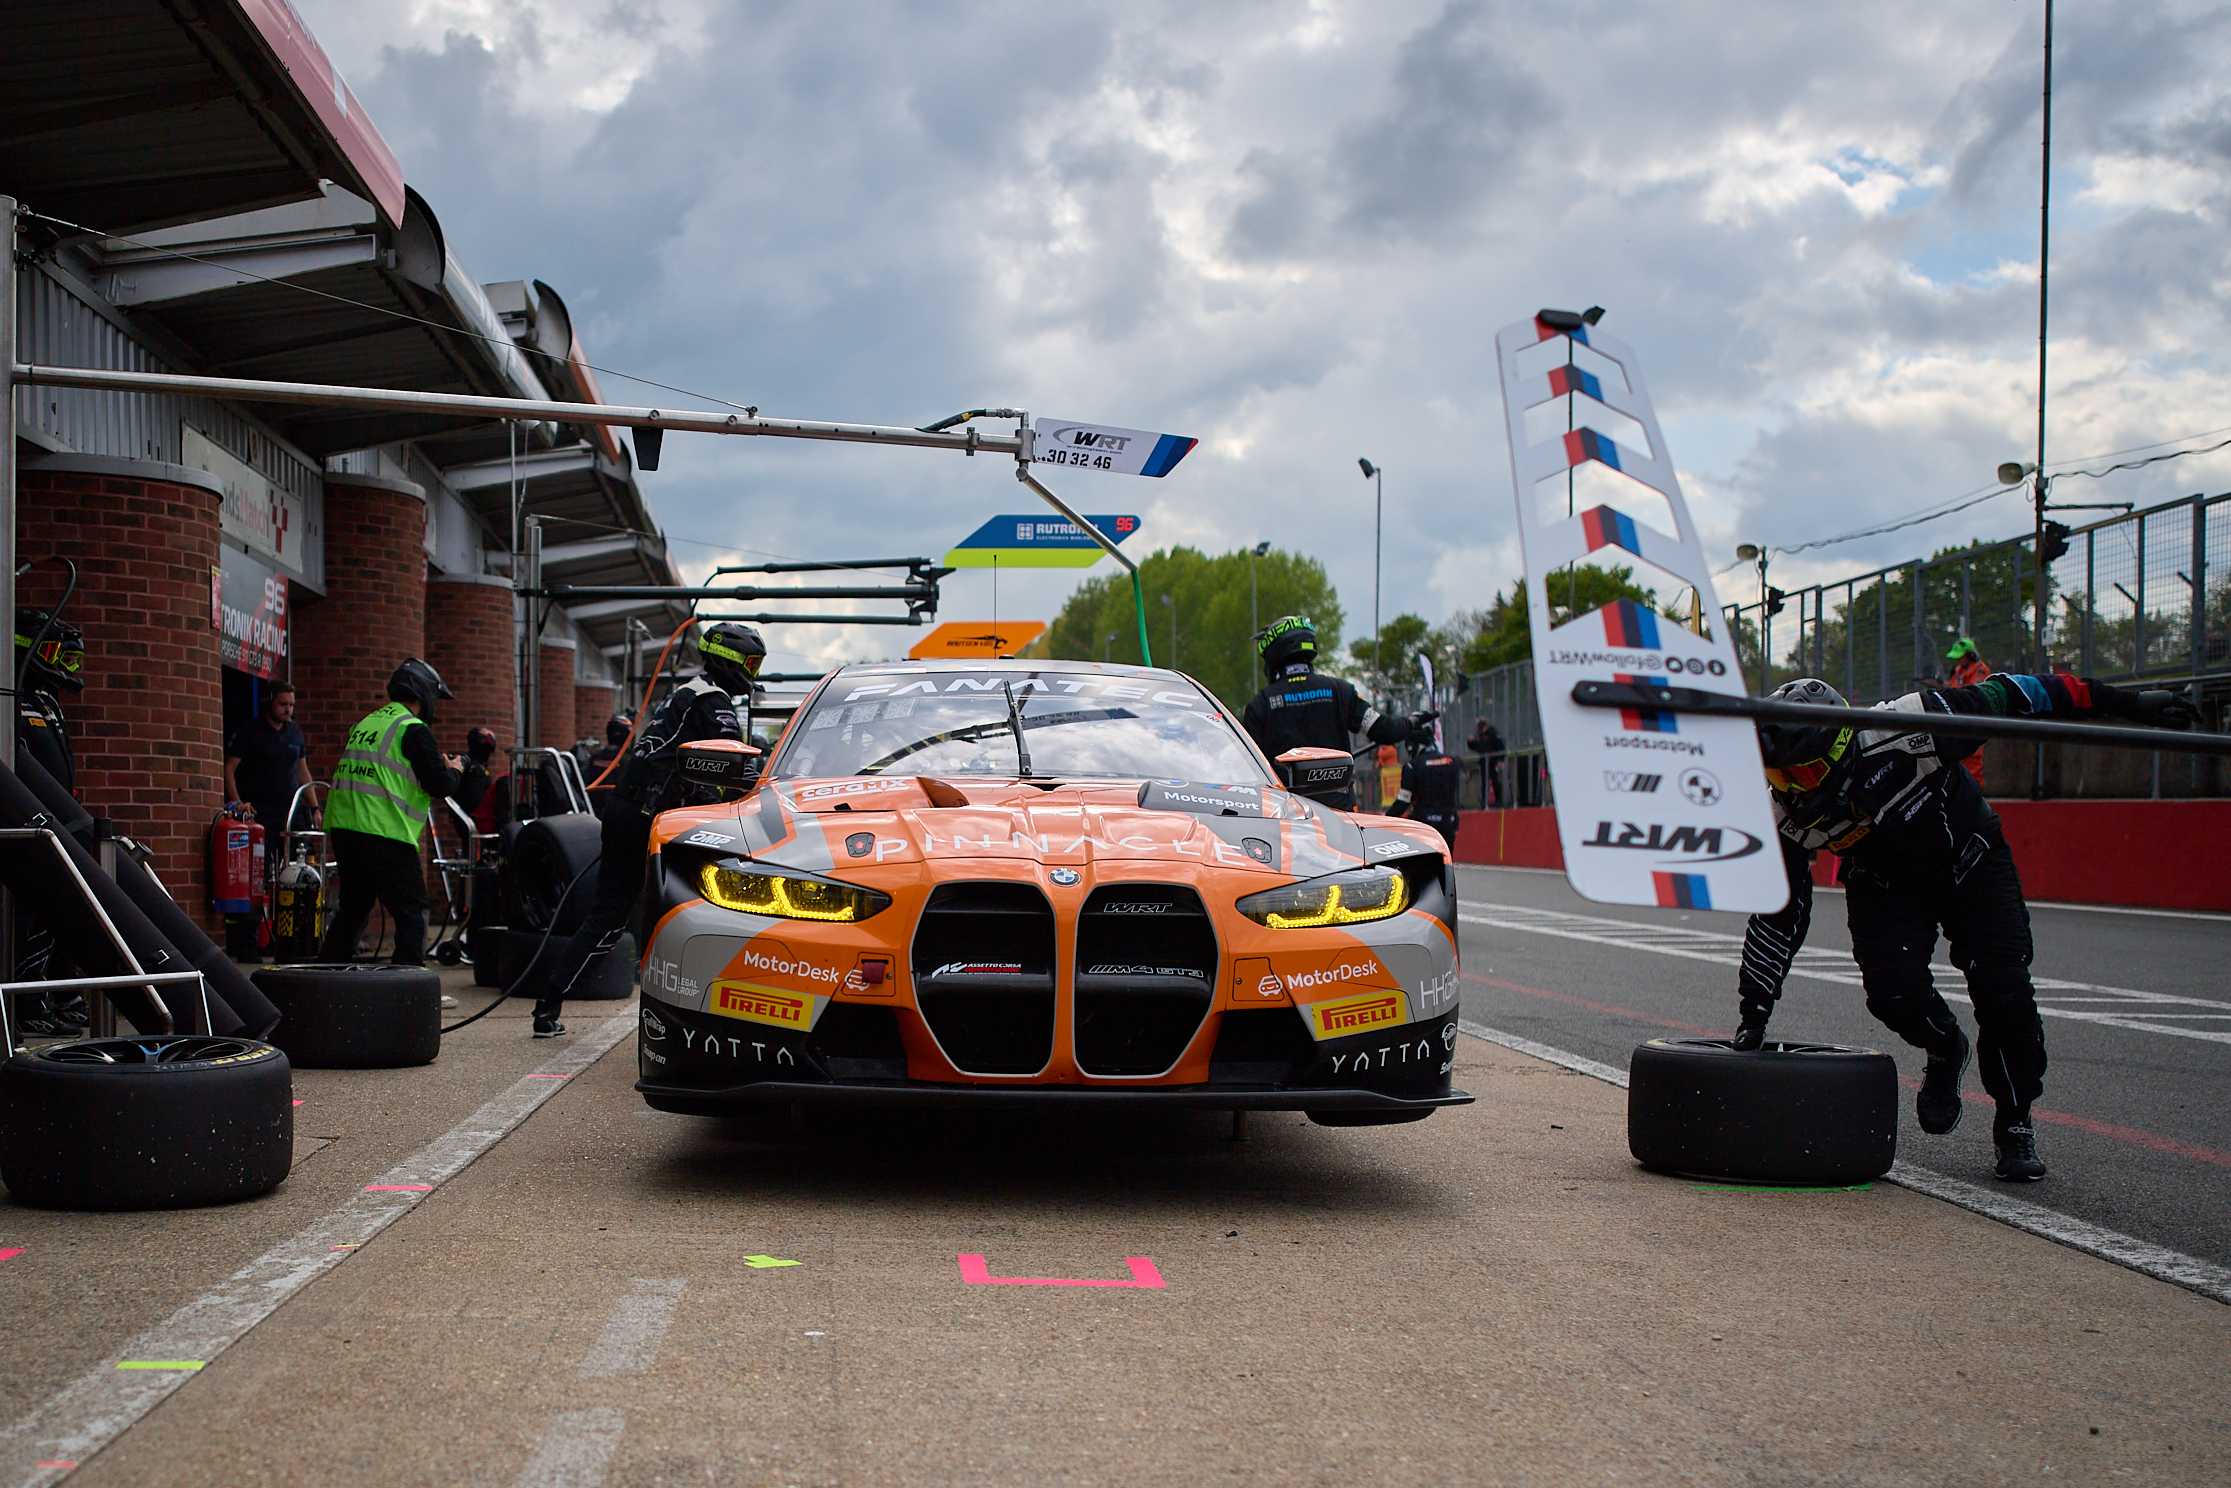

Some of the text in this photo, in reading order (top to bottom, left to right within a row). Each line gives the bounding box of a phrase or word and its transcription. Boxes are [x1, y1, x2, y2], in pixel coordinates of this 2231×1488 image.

[1073, 431, 1132, 451] WRT
[1047, 448, 1067, 464] 30
[1070, 451, 1089, 467] 32
[1093, 456, 1112, 469] 46
[1116, 516, 1134, 532] 96
[264, 577, 285, 615] 96
[254, 618, 287, 657] RACING
[844, 677, 1202, 707] FANATEC
[1603, 735, 1706, 756] Motorsport
[349, 764, 376, 778] LANE
[686, 757, 730, 772] WRT
[1307, 767, 1348, 782] WRT
[1163, 791, 1260, 810] Motorsport
[690, 832, 730, 846] OMP
[876, 832, 1247, 866] PINNACLE
[1374, 842, 1411, 855] OMP
[1582, 820, 1726, 855] WRT
[1103, 902, 1173, 913] WRT
[744, 950, 840, 984] MotorDesk
[1287, 959, 1378, 990] MotorDesk
[719, 986, 804, 1021] PIRELLI
[1321, 997, 1397, 1031] PIRELLI
[683, 1027, 795, 1066] YATTA
[1332, 1039, 1430, 1073] YATTA
